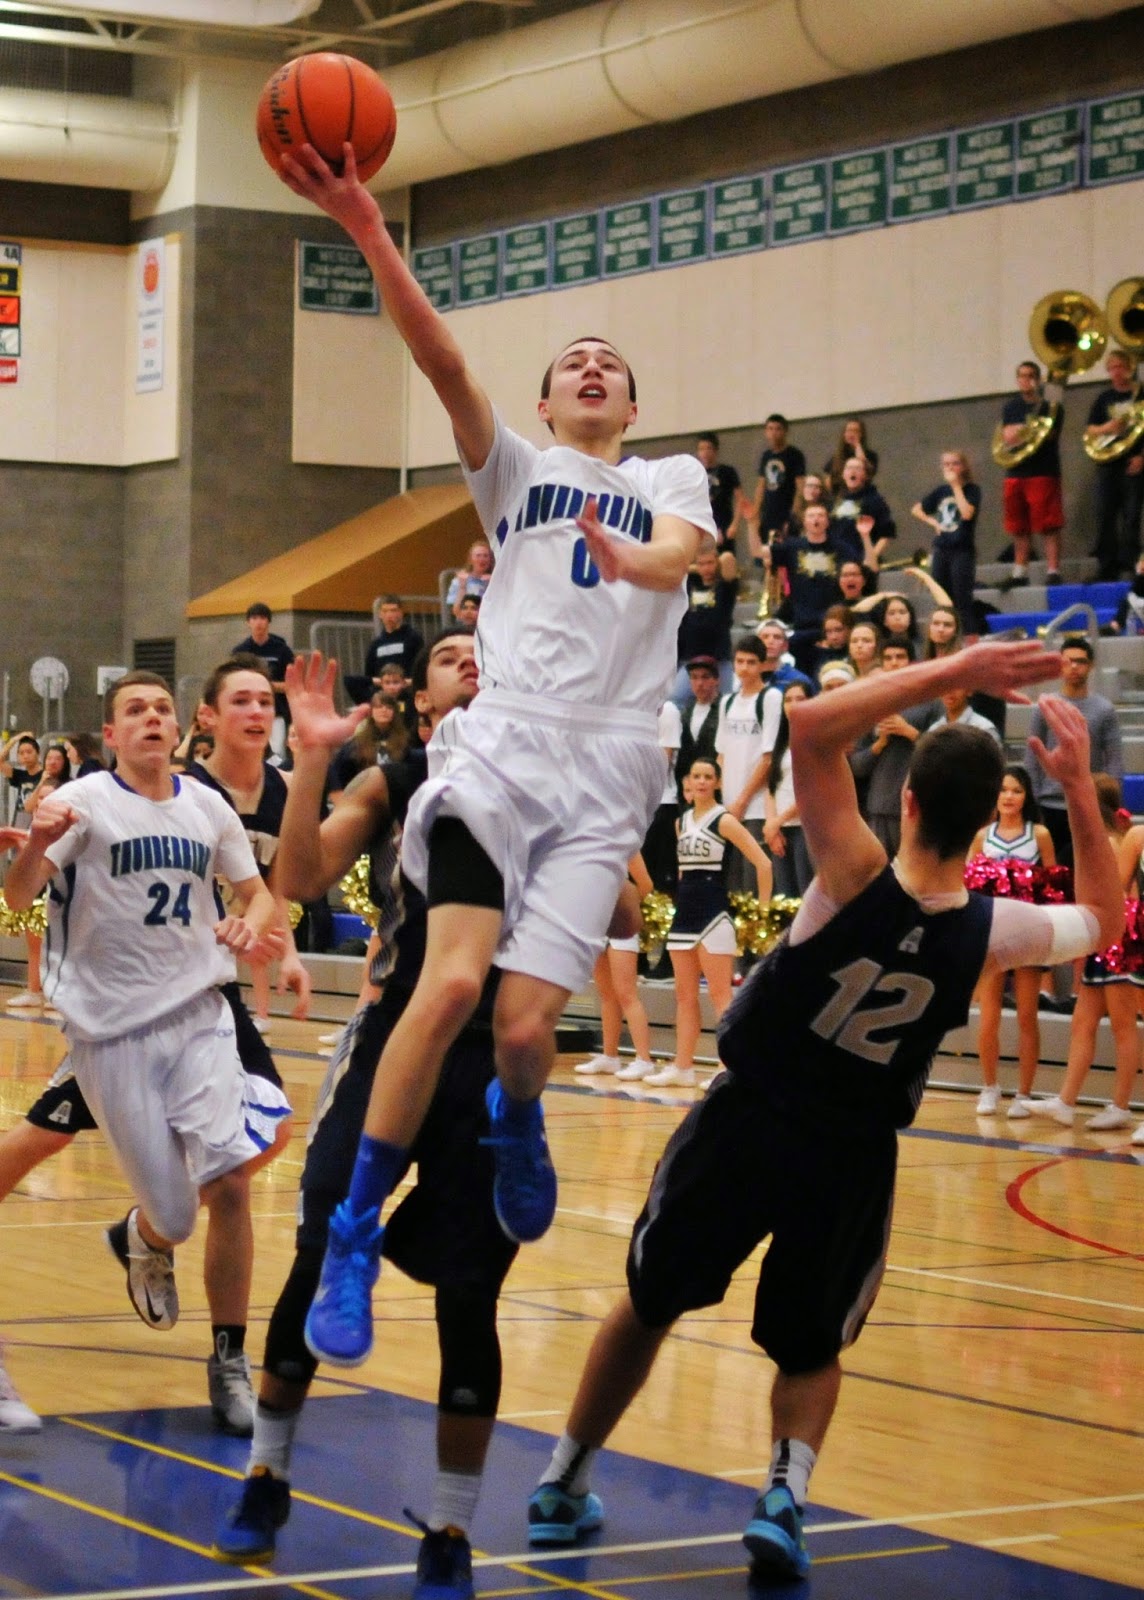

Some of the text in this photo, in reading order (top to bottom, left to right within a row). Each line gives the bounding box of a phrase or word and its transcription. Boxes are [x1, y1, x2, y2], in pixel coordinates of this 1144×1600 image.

[571, 537, 601, 589] 0
[143, 882, 192, 928] 24
[808, 956, 936, 1066] 12
